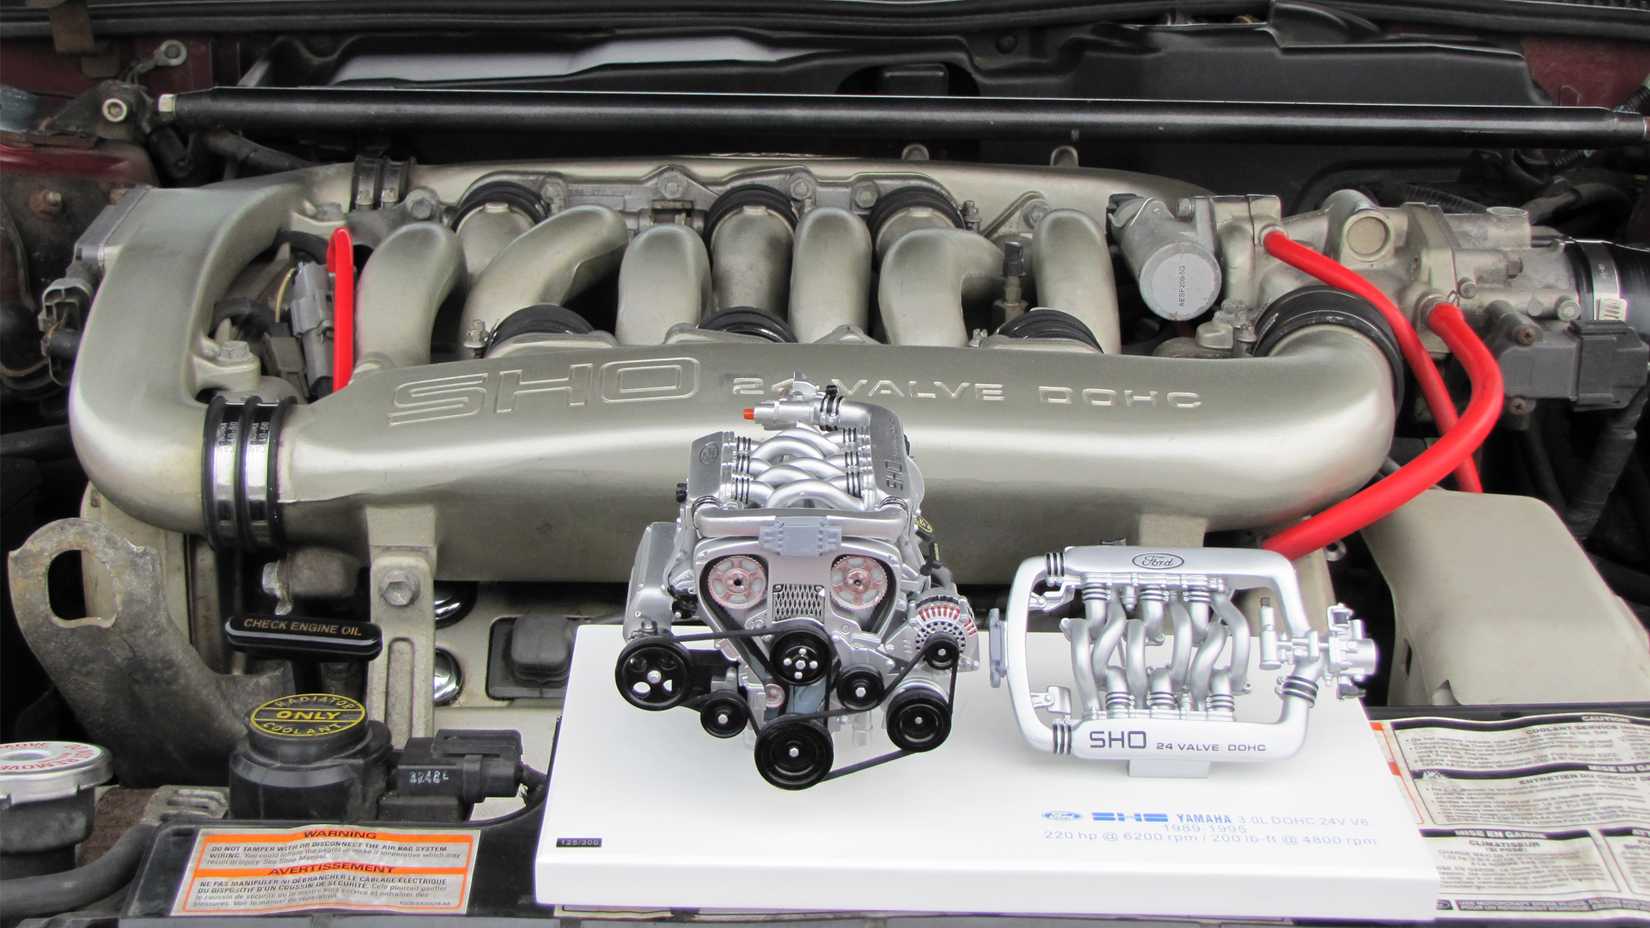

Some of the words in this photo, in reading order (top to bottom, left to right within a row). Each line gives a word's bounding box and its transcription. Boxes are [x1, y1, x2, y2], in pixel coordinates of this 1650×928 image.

[387, 356, 700, 427] SHO
[831, 379, 1005, 401] VALVE
[1038, 386, 1203, 408] DOHC
[1142, 555, 1176, 567] Ford
[243, 618, 287, 630] CHECK
[290, 622, 338, 635] ENGINE
[341, 626, 362, 636] OIL
[273, 695, 356, 709] RADIATOR
[276, 710, 341, 721] ONLY
[263, 722, 341, 735] COOLANT
[1089, 730, 1147, 750] SHO
[1156, 742, 1174, 751] 24
[1177, 743, 1220, 752] VALVE
[1227, 744, 1267, 752] DOHC
[1176, 813, 1232, 824] YAMAHA
[303, 830, 377, 839] WARNING
[1044, 831, 1074, 841] 220
[1078, 832, 1098, 842] hp
[1102, 831, 1119, 842] @
[1123, 831, 1164, 841] 6200
[1168, 834, 1200, 844] rpm
[1212, 834, 1241, 843] 200
[1302, 836, 1342, 845] 4800
[1346, 837, 1378, 847] rpm
[267, 863, 395, 876] AVERTISSEMENT
